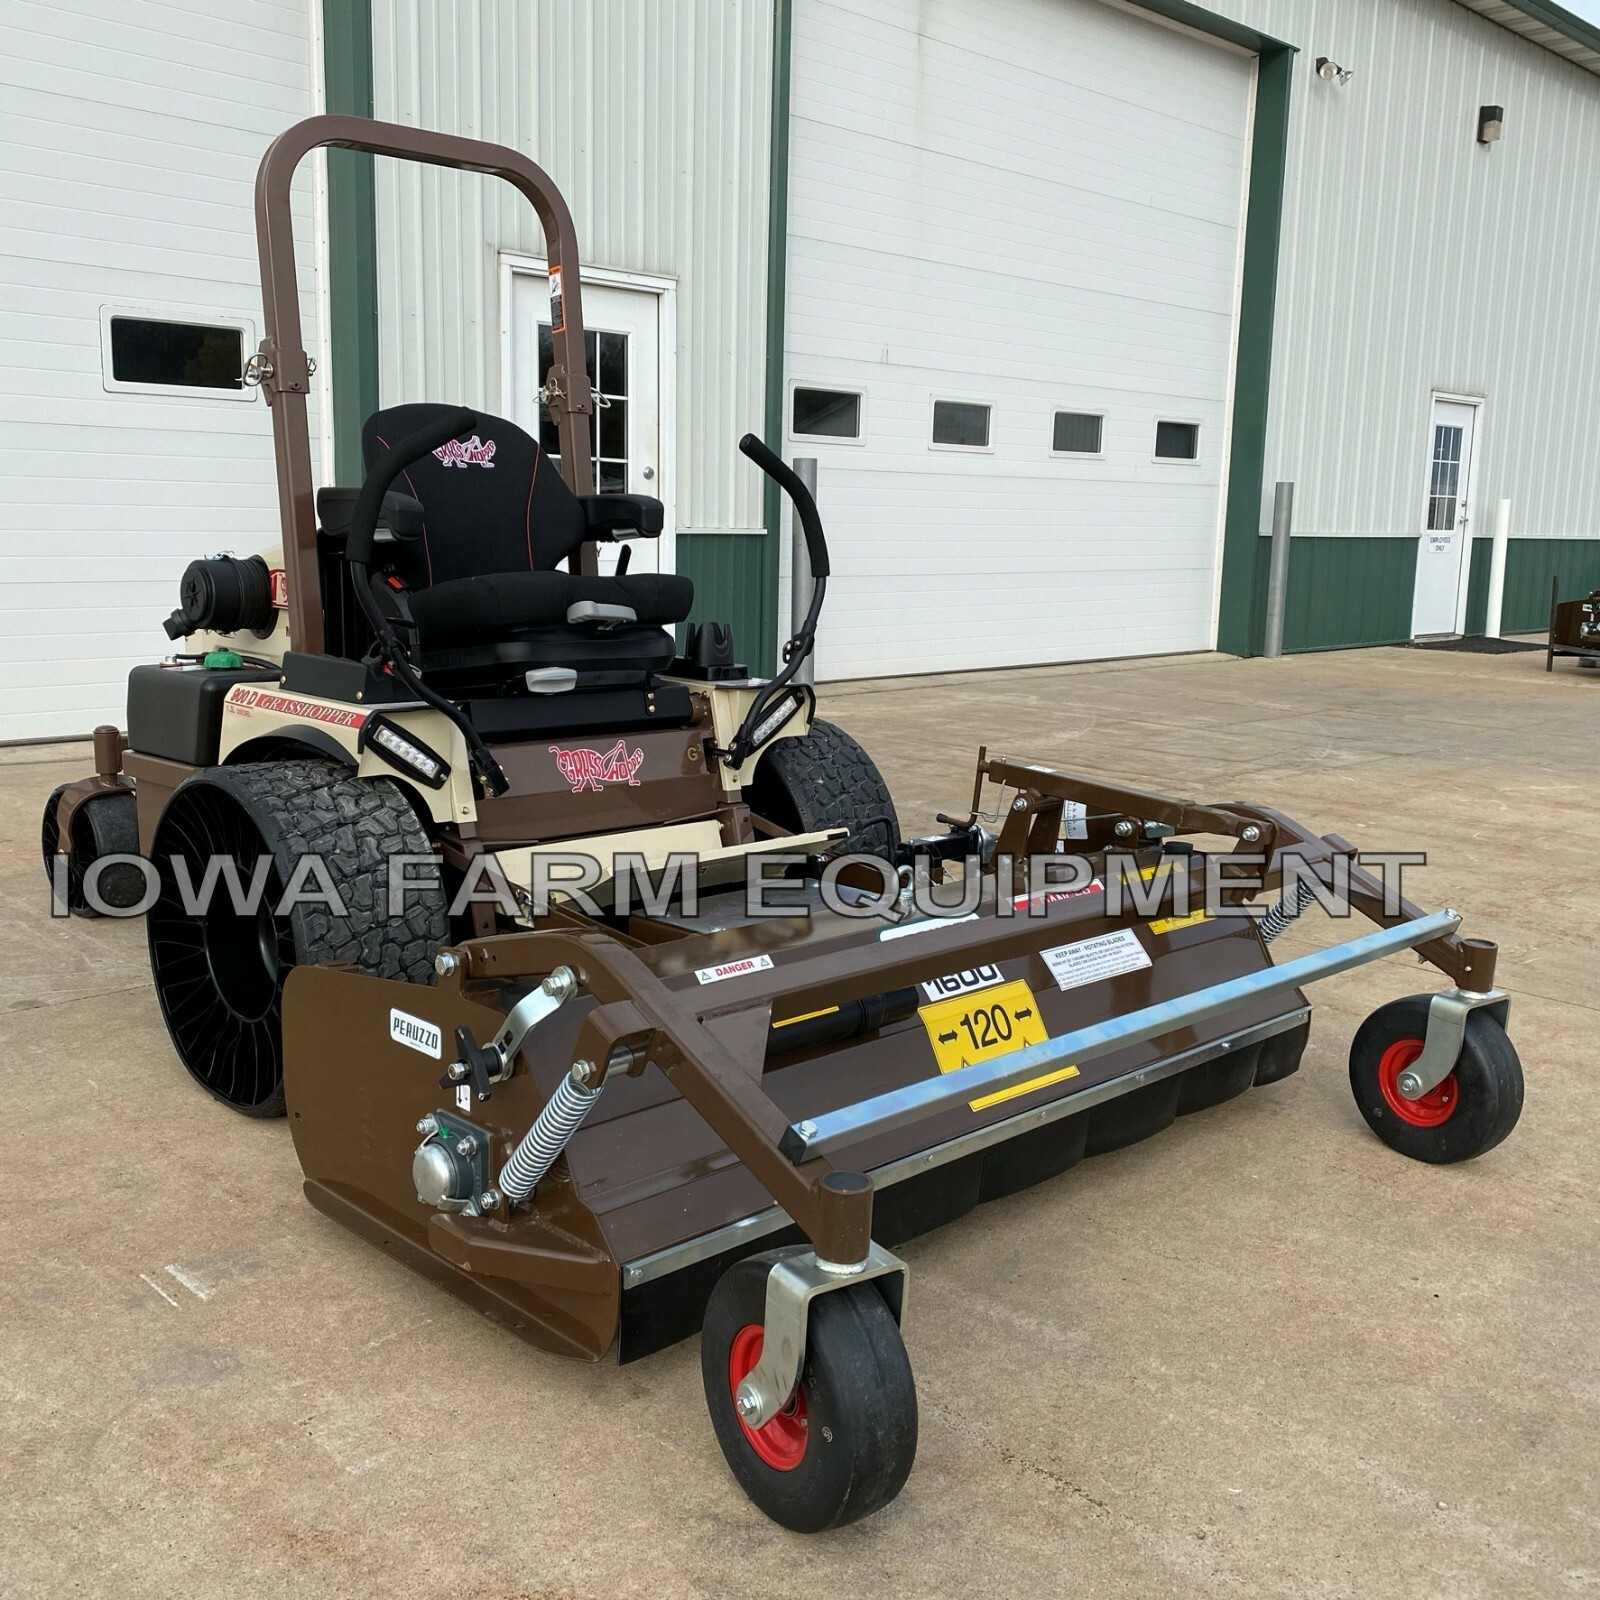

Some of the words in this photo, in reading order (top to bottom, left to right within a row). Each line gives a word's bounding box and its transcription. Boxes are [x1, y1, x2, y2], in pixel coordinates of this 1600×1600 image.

[230, 688, 247, 704] 900
[247, 691, 258, 706] D
[260, 695, 356, 726] GRASSHOPPER
[1084, 941, 1107, 951] ROTATING
[1107, 936, 1125, 944] BLADES
[715, 960, 755, 977] DANGER
[393, 1017, 438, 1050] PERUZZO
[960, 1003, 1013, 1050] 120
